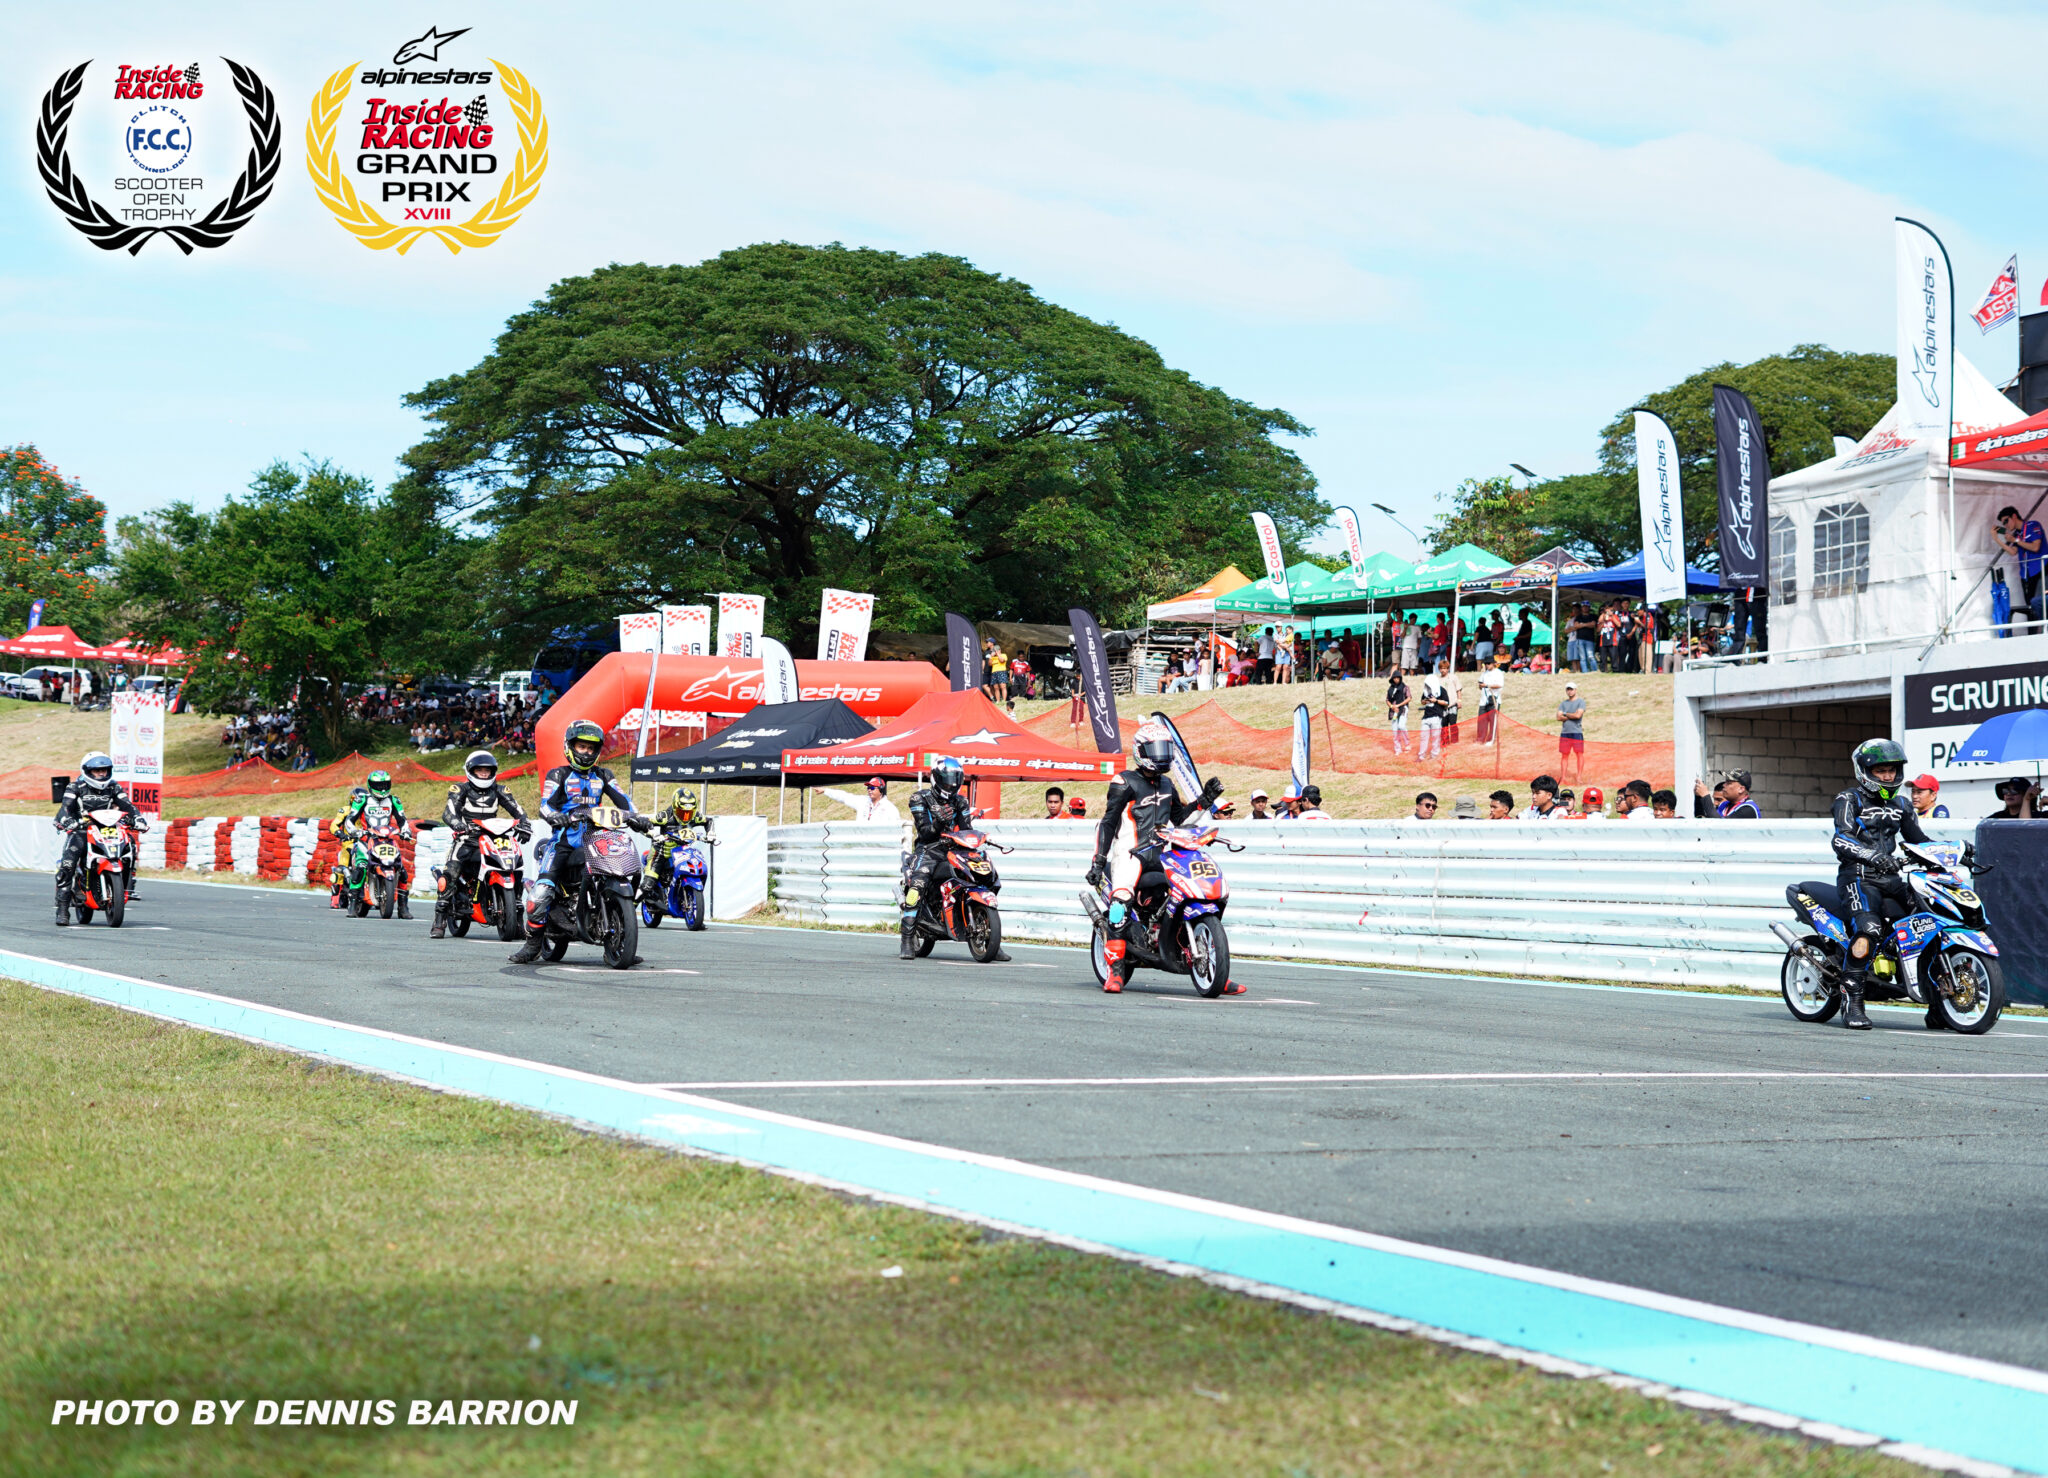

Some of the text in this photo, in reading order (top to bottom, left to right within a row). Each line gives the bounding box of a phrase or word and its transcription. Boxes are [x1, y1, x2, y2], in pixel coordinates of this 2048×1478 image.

[1922, 256, 1938, 366] alpinestars
[1656, 439, 1672, 536] alpinestars
[1737, 418, 1755, 521] alpinestars
[1260, 524, 1281, 569] Castrol
[1085, 626, 1107, 708] alpinestars
[133, 789, 158, 803] BIKE
[380, 847, 394, 856] 22
[1191, 862, 1217, 876] 95
[1913, 918, 1933, 926] TUNE
